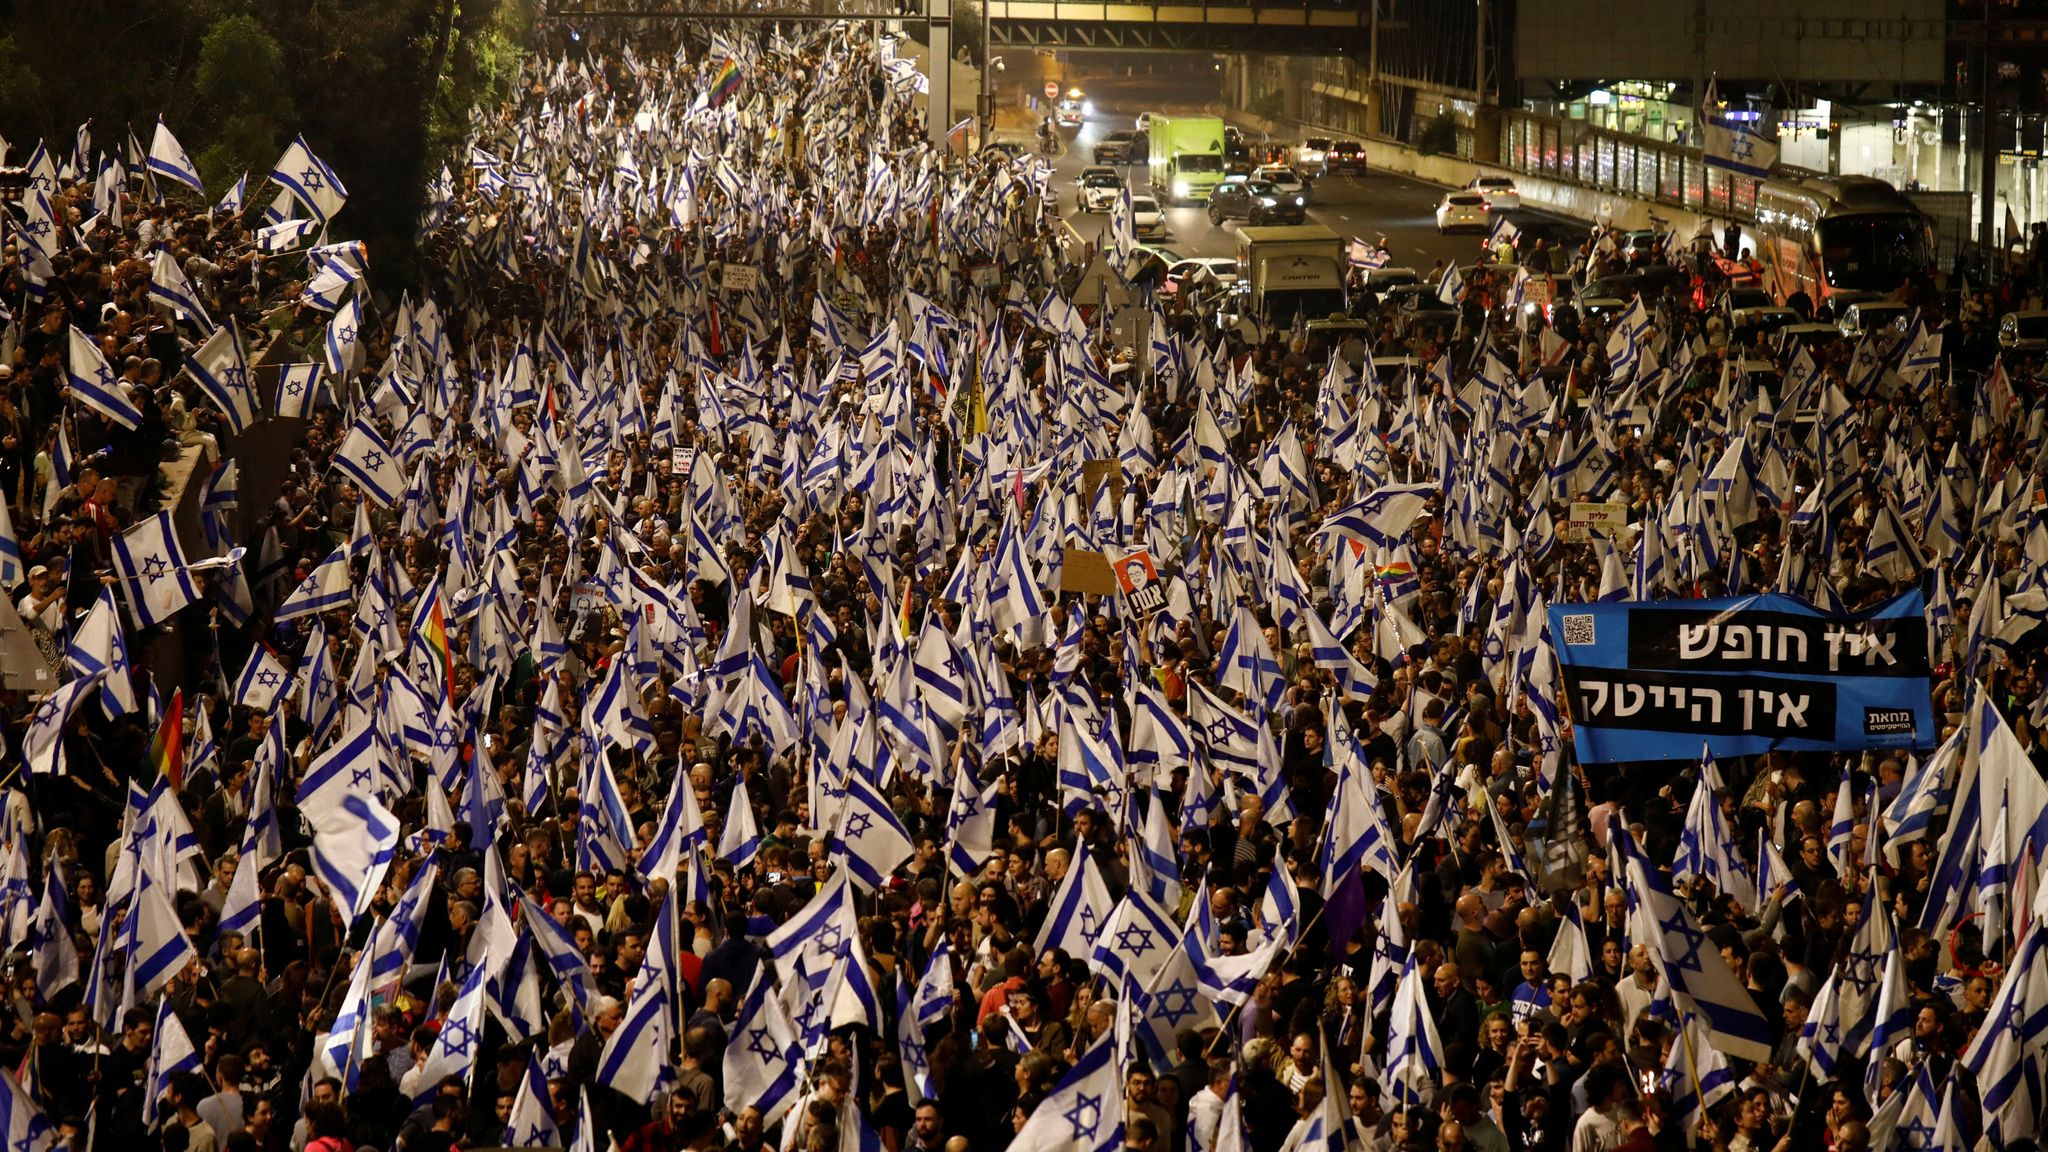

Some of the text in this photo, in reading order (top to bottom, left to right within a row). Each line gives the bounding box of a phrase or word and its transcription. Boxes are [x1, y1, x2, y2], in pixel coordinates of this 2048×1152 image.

[1678, 623, 1897, 672] אין חופש
[1579, 680, 1811, 731] אין הייטק
[1869, 712, 1910, 724] מחאת
